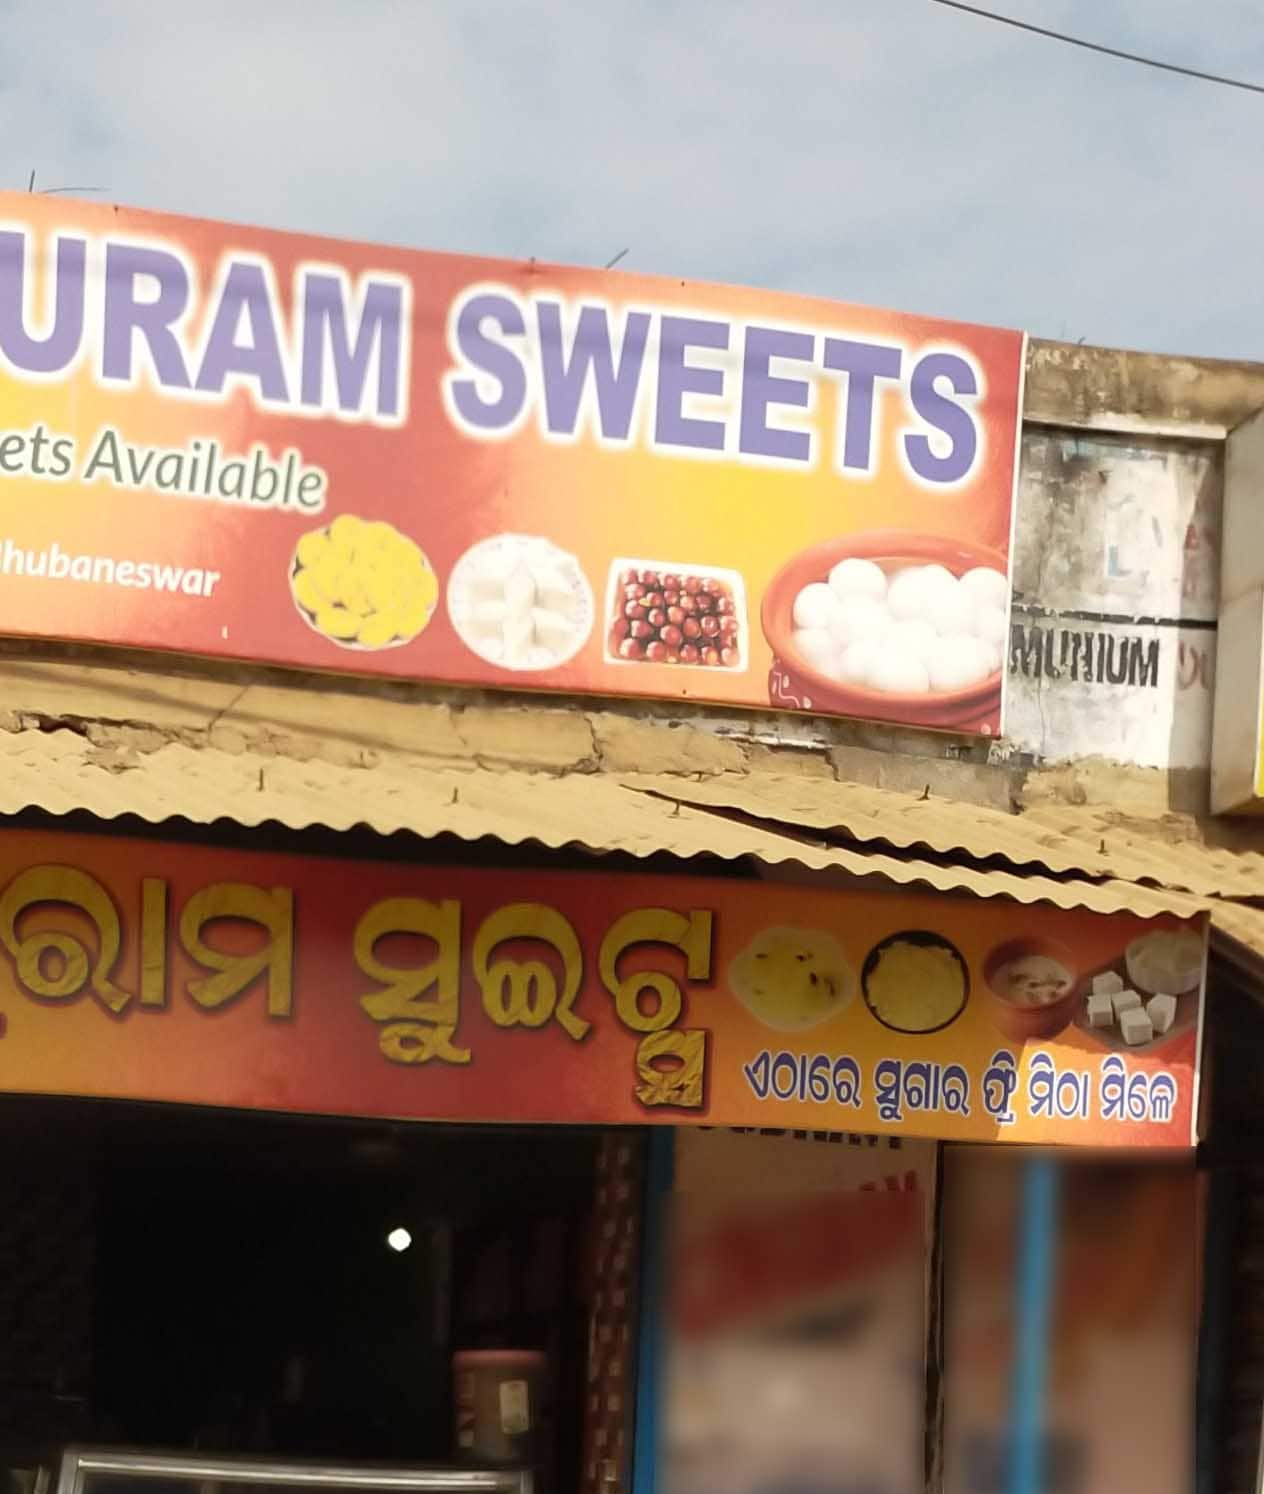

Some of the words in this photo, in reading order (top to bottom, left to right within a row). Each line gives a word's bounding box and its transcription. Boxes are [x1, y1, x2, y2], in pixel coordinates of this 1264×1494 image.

[450, 292, 979, 484] SWEETS
[83, 429, 322, 507] Available
[744, 1050, 861, 1108] ଏଠାରେ
[874, 1059, 970, 1121] ସୁଗାର
[1029, 1053, 1089, 1117] ମିଠା
